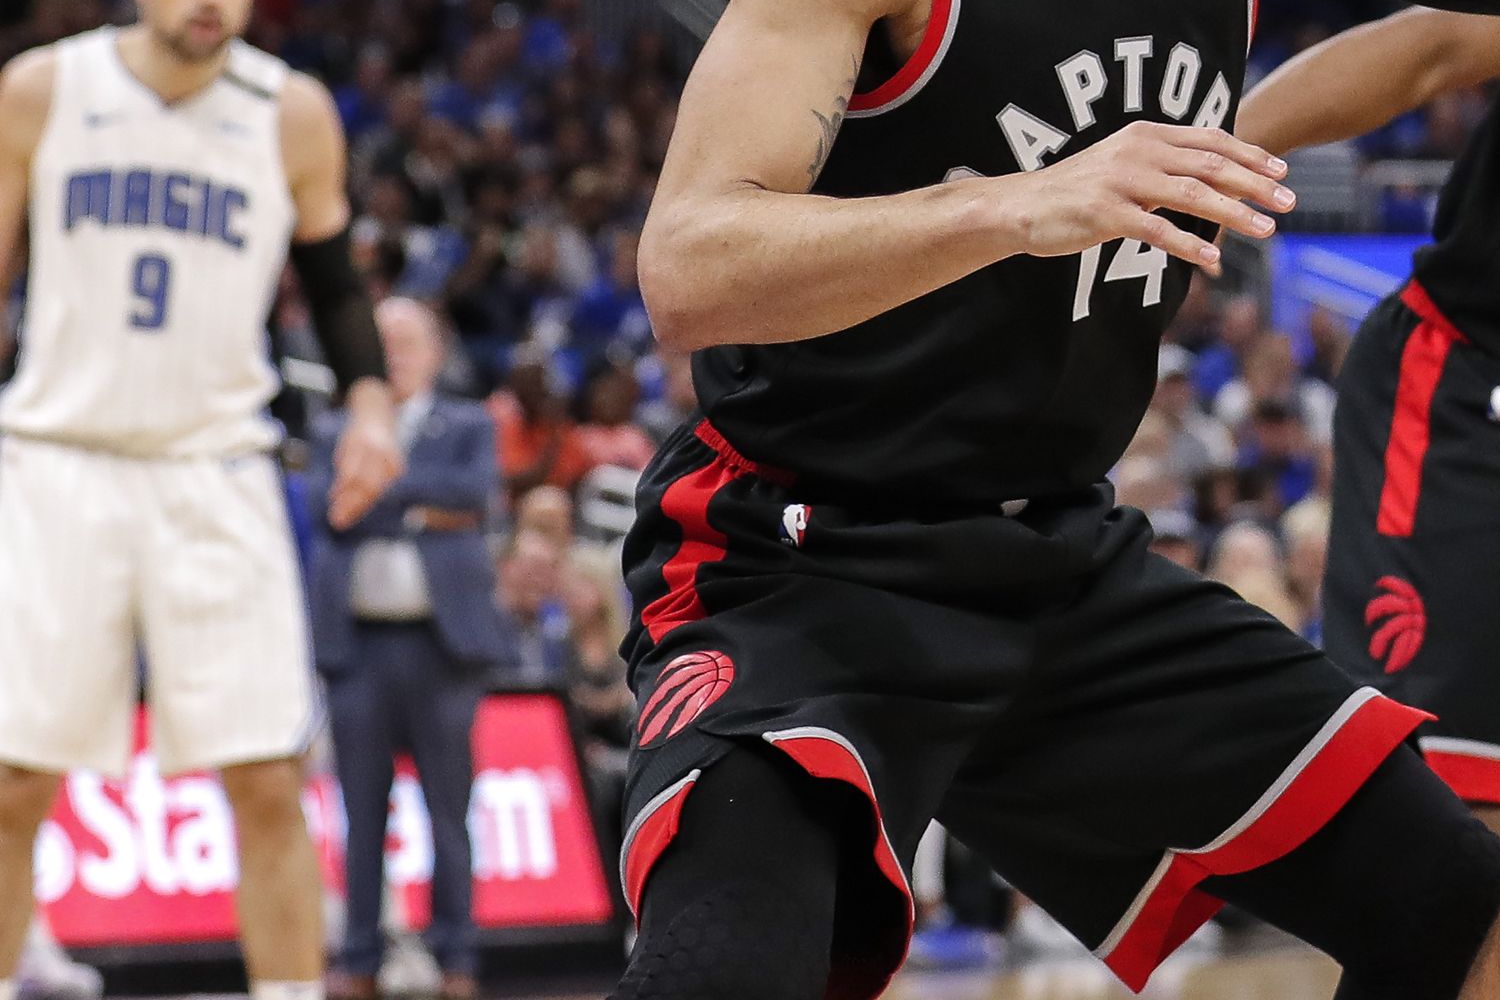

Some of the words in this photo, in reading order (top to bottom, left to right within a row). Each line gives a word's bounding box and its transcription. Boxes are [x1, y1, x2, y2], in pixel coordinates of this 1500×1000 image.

[942, 34, 1232, 184] APTOR
[64, 168, 248, 248] MAGIC
[128, 251, 171, 331] 9
